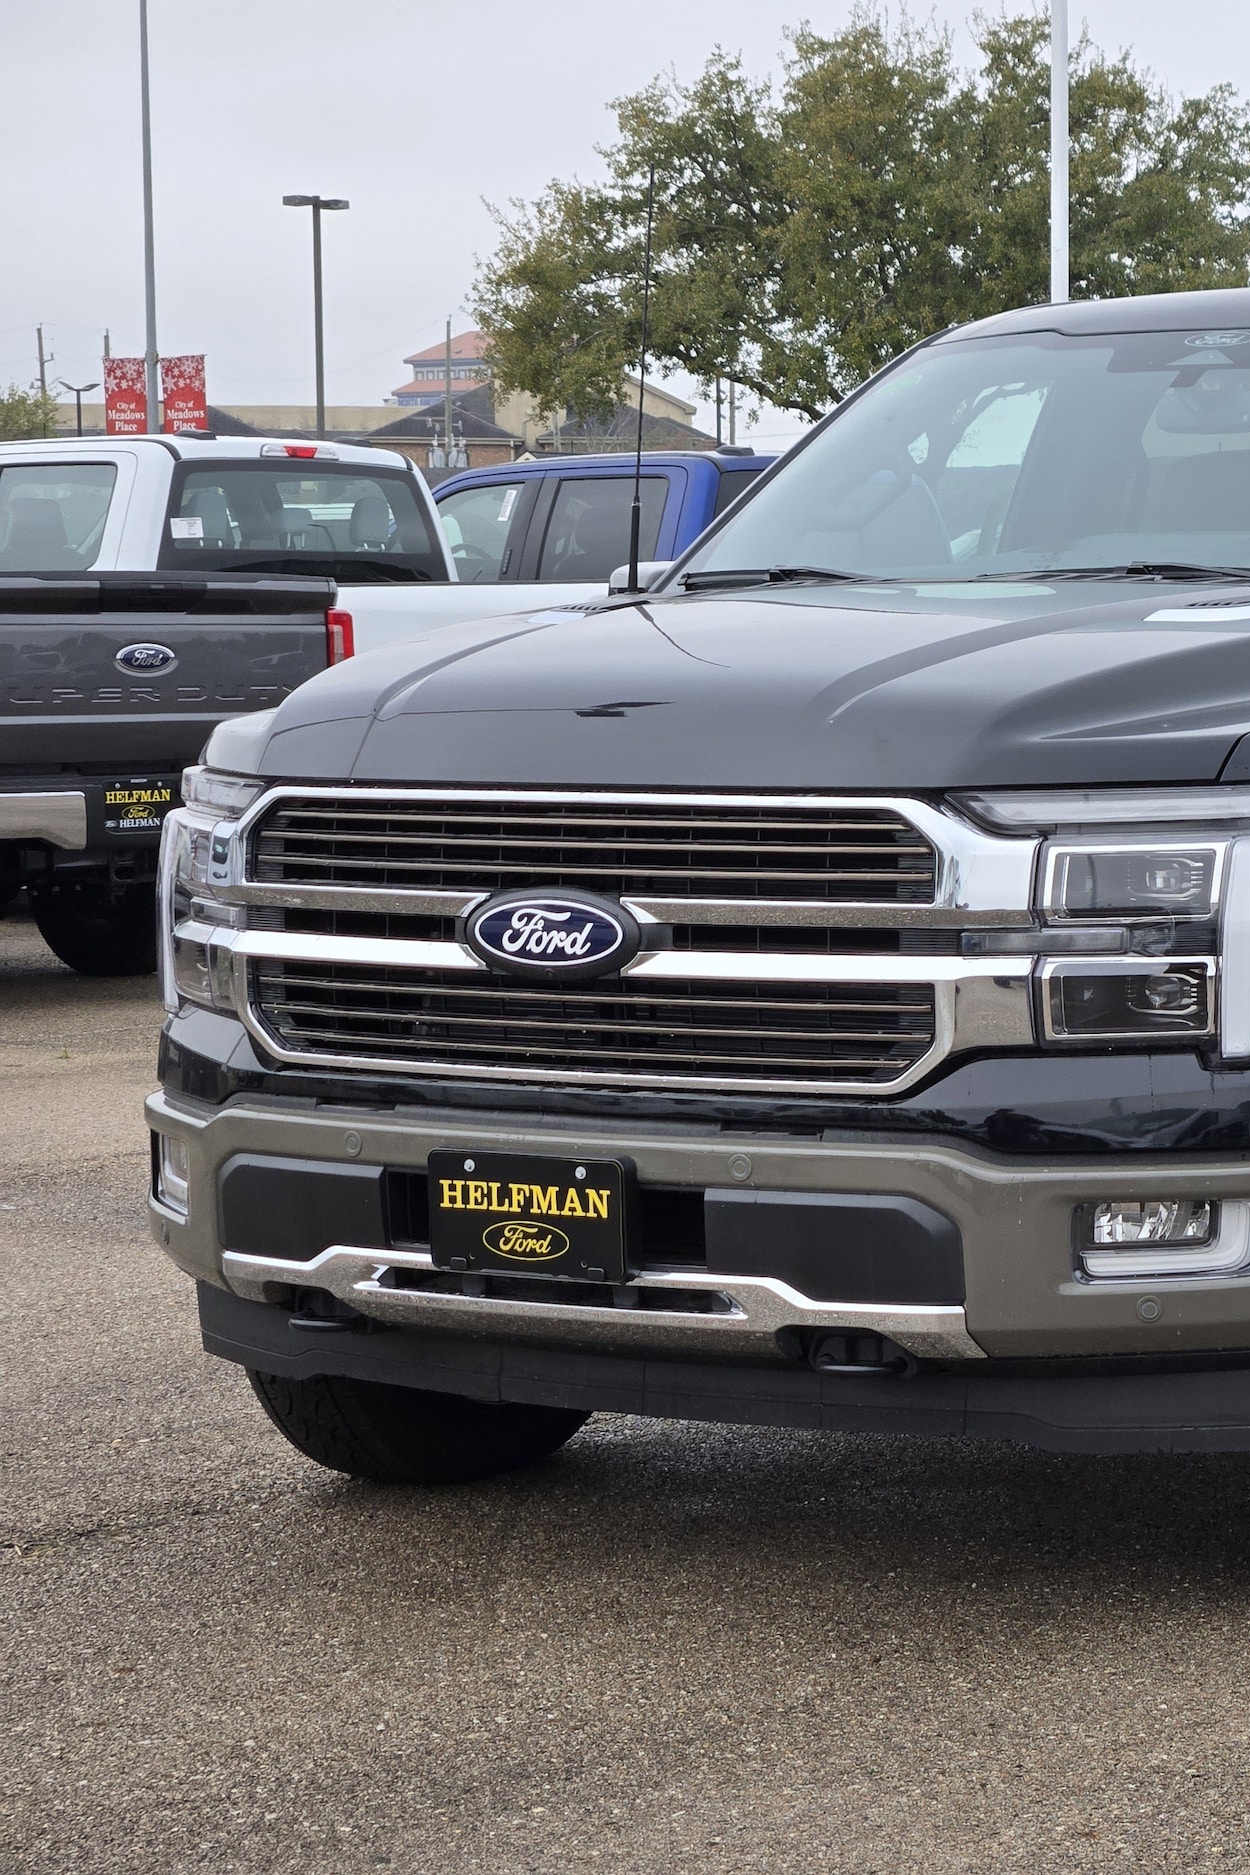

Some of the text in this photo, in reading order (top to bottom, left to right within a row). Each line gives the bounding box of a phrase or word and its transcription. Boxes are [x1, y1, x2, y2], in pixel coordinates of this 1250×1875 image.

[1195, 333, 1245, 345] Ford
[116, 402, 129, 410] City
[174, 400, 194, 409] City of
[107, 410, 145, 420] Meadows
[166, 409, 205, 420] Meadows
[115, 421, 138, 431] Place
[173, 420, 197, 431] Place
[131, 649, 163, 667] Ford
[105, 788, 171, 804] HELFMAN
[128, 807, 149, 818] Ford
[120, 818, 161, 828] HELFMAN
[502, 908, 594, 956] Ford
[438, 1179, 610, 1219] HELFMAN
[499, 1224, 553, 1254] Ford
